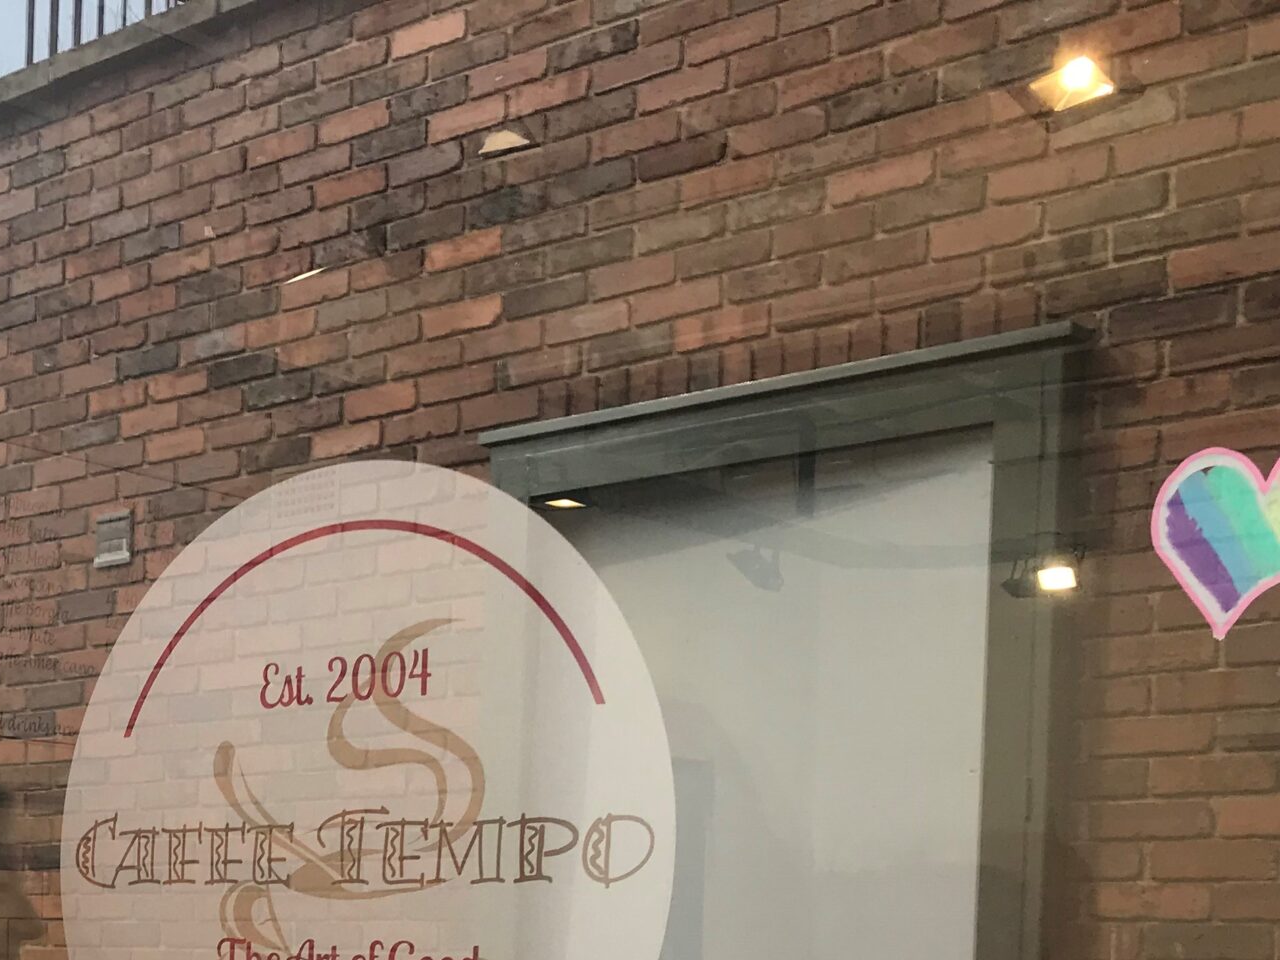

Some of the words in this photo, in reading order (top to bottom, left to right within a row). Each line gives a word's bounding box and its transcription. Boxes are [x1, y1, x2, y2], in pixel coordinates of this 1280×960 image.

[260, 663, 314, 710] Est.
[326, 647, 432, 703] 2004
[317, 805, 656, 889] TEMPO
